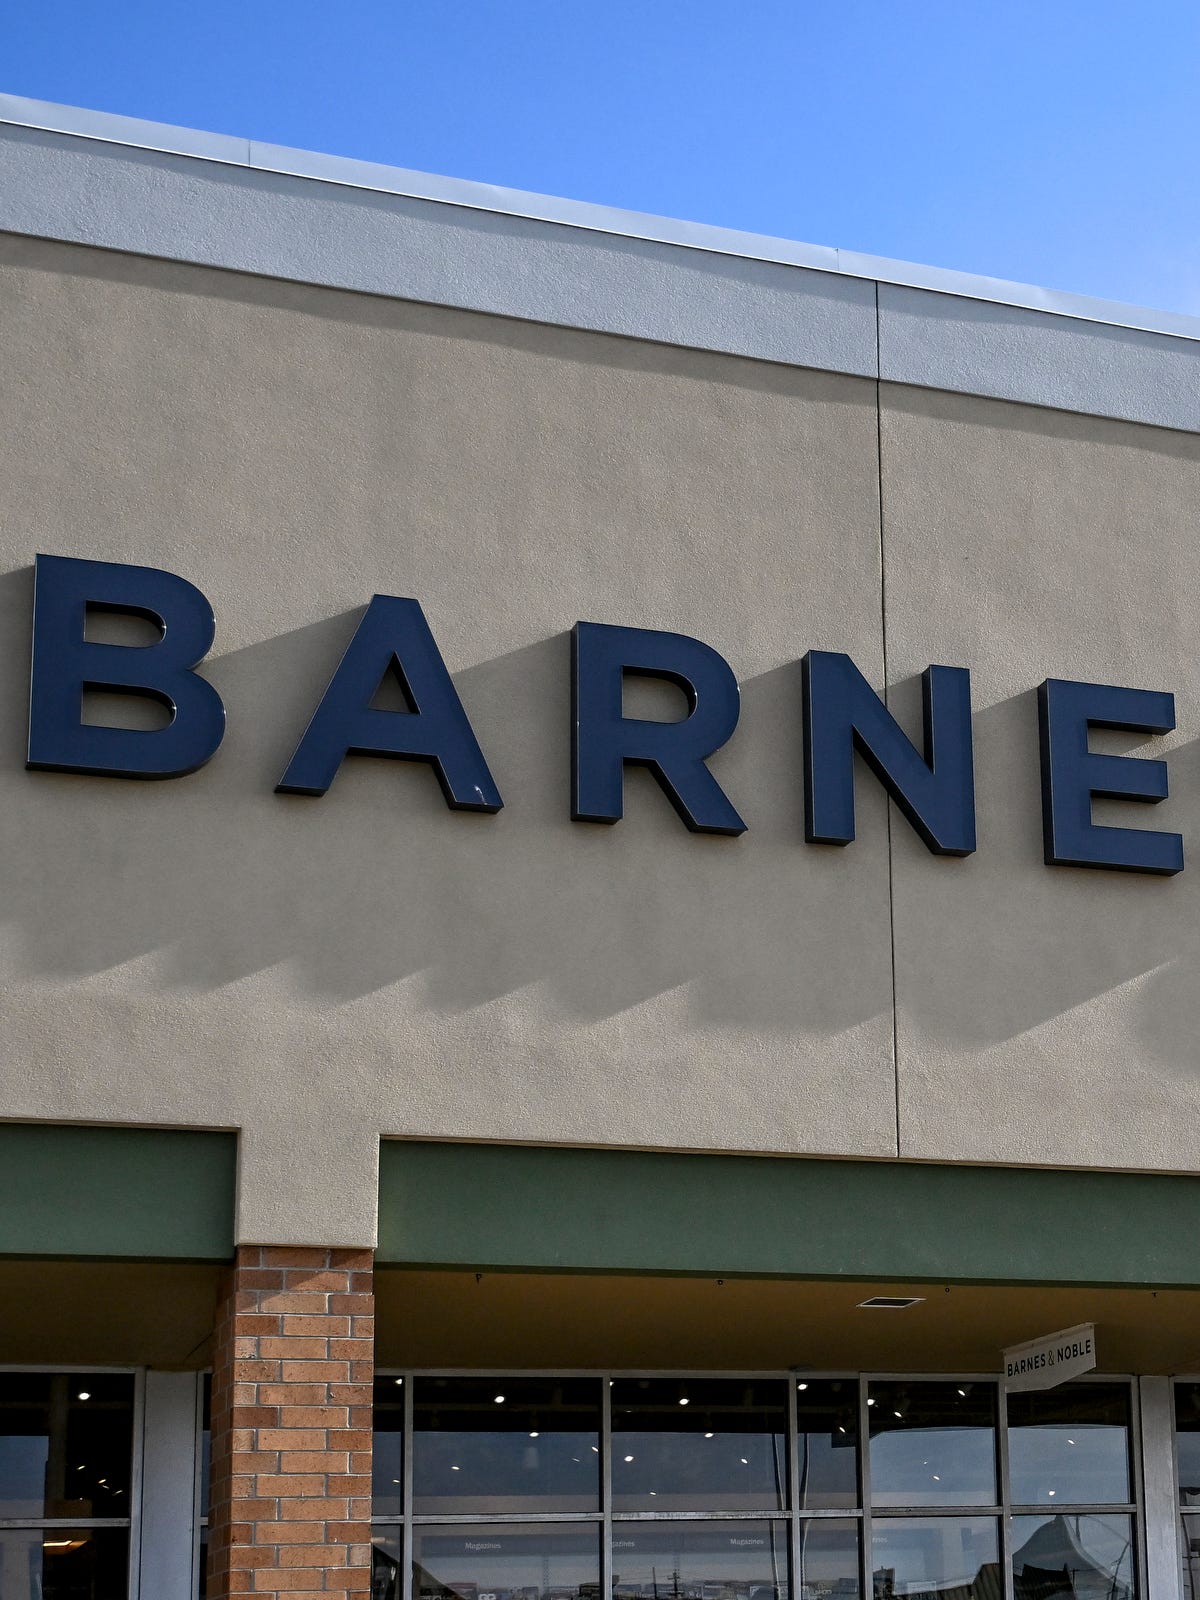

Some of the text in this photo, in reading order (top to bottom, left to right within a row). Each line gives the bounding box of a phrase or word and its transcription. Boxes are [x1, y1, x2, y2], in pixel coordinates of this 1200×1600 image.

[1007, 1340, 1091, 1377] BARNES & NOBLE
[465, 1542, 501, 1550] Magazines
[730, 1538, 764, 1546] Magazines
